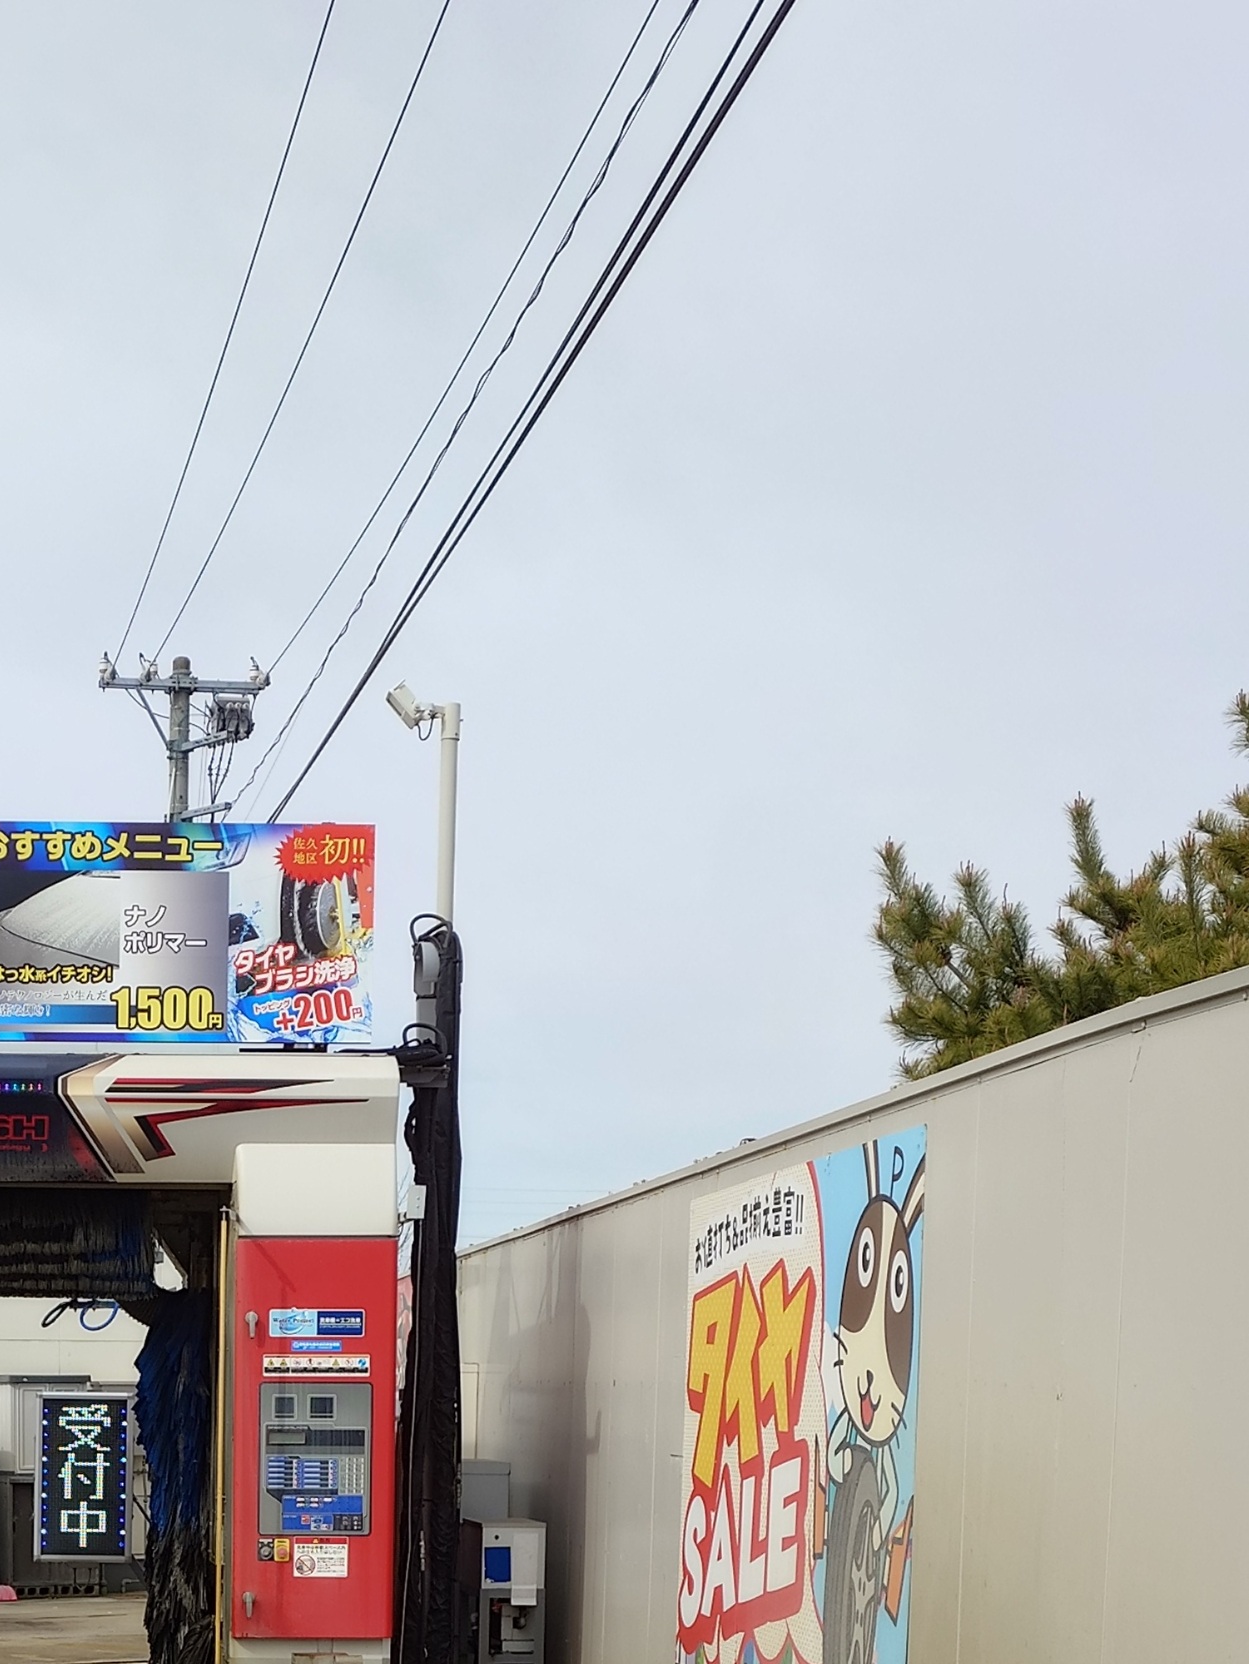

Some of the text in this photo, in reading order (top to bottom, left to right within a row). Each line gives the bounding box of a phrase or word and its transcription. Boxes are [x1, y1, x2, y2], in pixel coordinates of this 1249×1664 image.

[124, 905, 167, 928] ナノ
[124, 931, 208, 955] ポリマー
[235, 944, 296, 974] タイヤ
[255, 956, 357, 995] ブラシ洗浄
[110, 985, 223, 1031] 1,500円
[58, 1404, 112, 1548] 受付中
[679, 1456, 803, 1629] SALE
